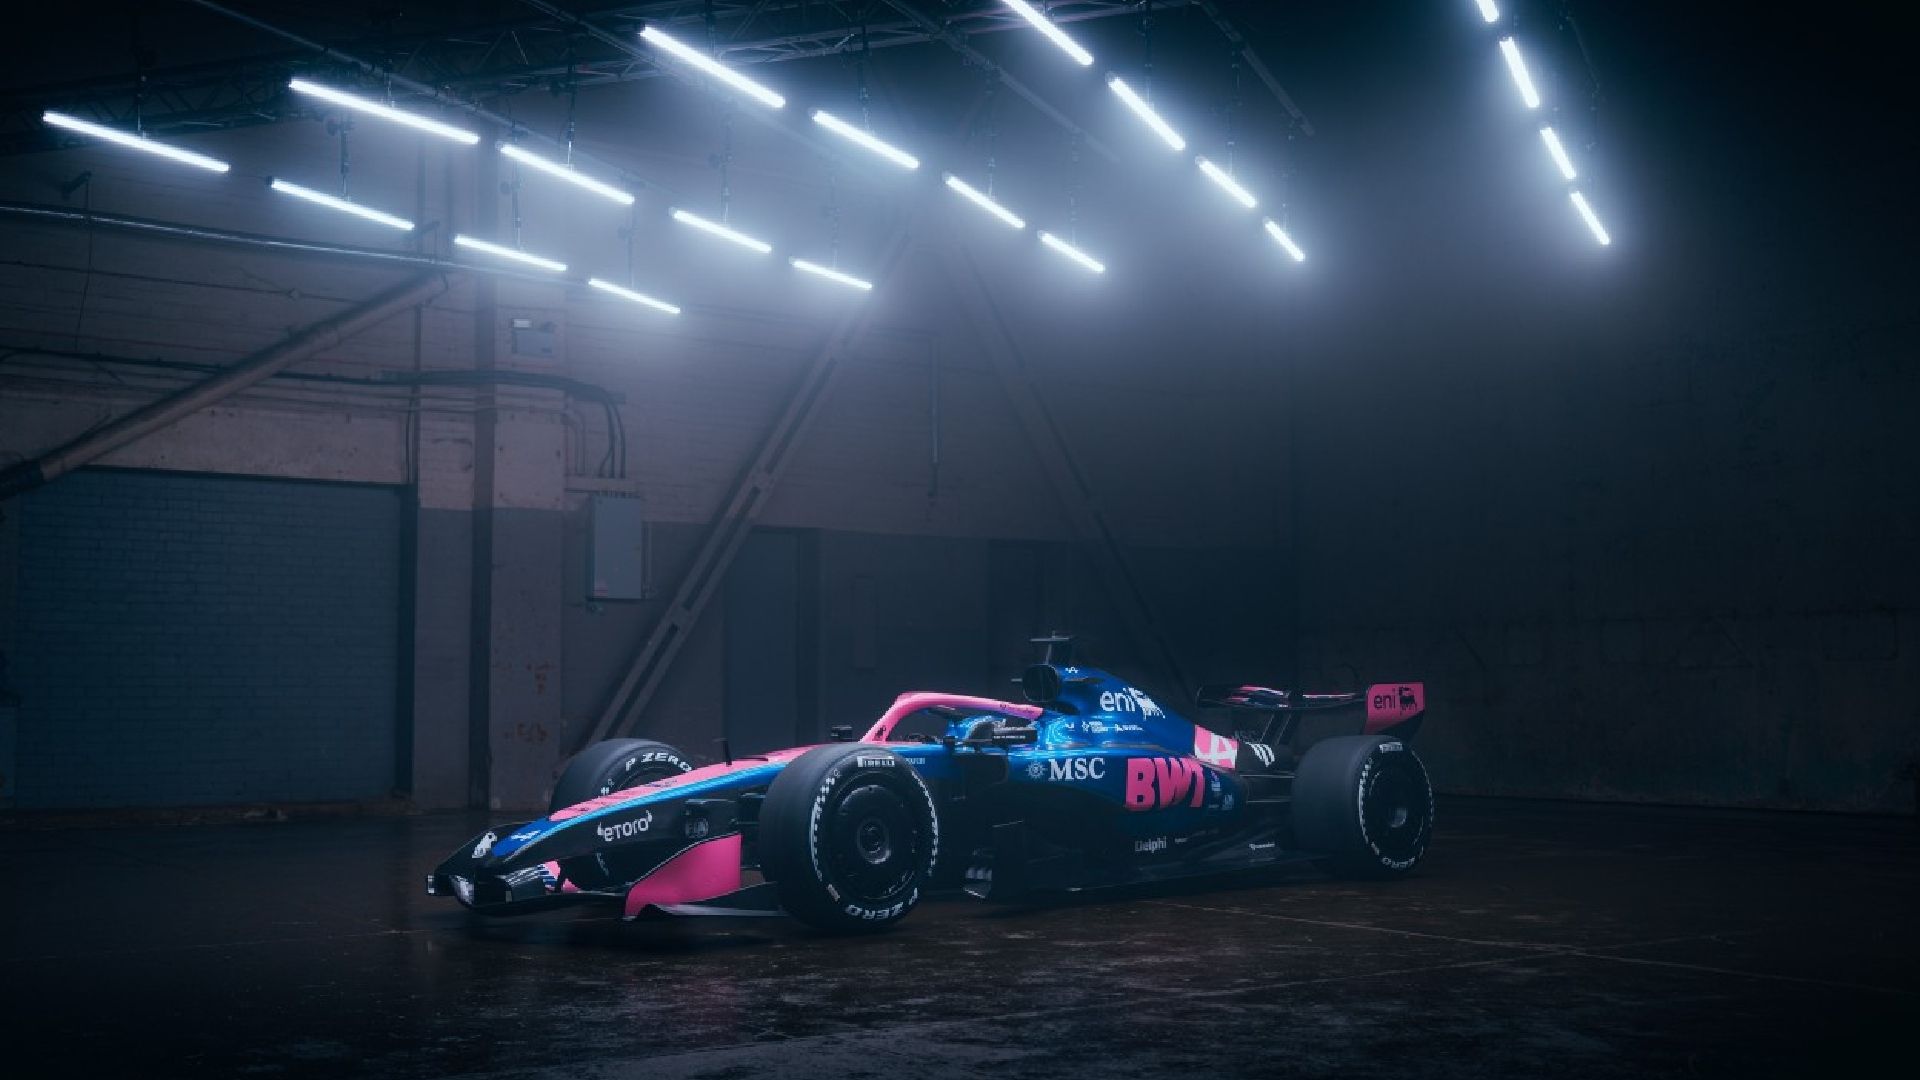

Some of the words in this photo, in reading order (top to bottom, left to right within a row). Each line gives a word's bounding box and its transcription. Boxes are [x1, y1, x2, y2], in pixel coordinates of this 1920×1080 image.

[1099, 687, 1136, 712] eni
[1373, 687, 1396, 709] eni
[625, 757, 636, 772] P
[641, 752, 692, 772] ZERO
[1048, 757, 1105, 781] MSC
[1125, 757, 1206, 812] BWT
[1134, 836, 1167, 853] Delphi
[845, 901, 904, 920] ZERO
